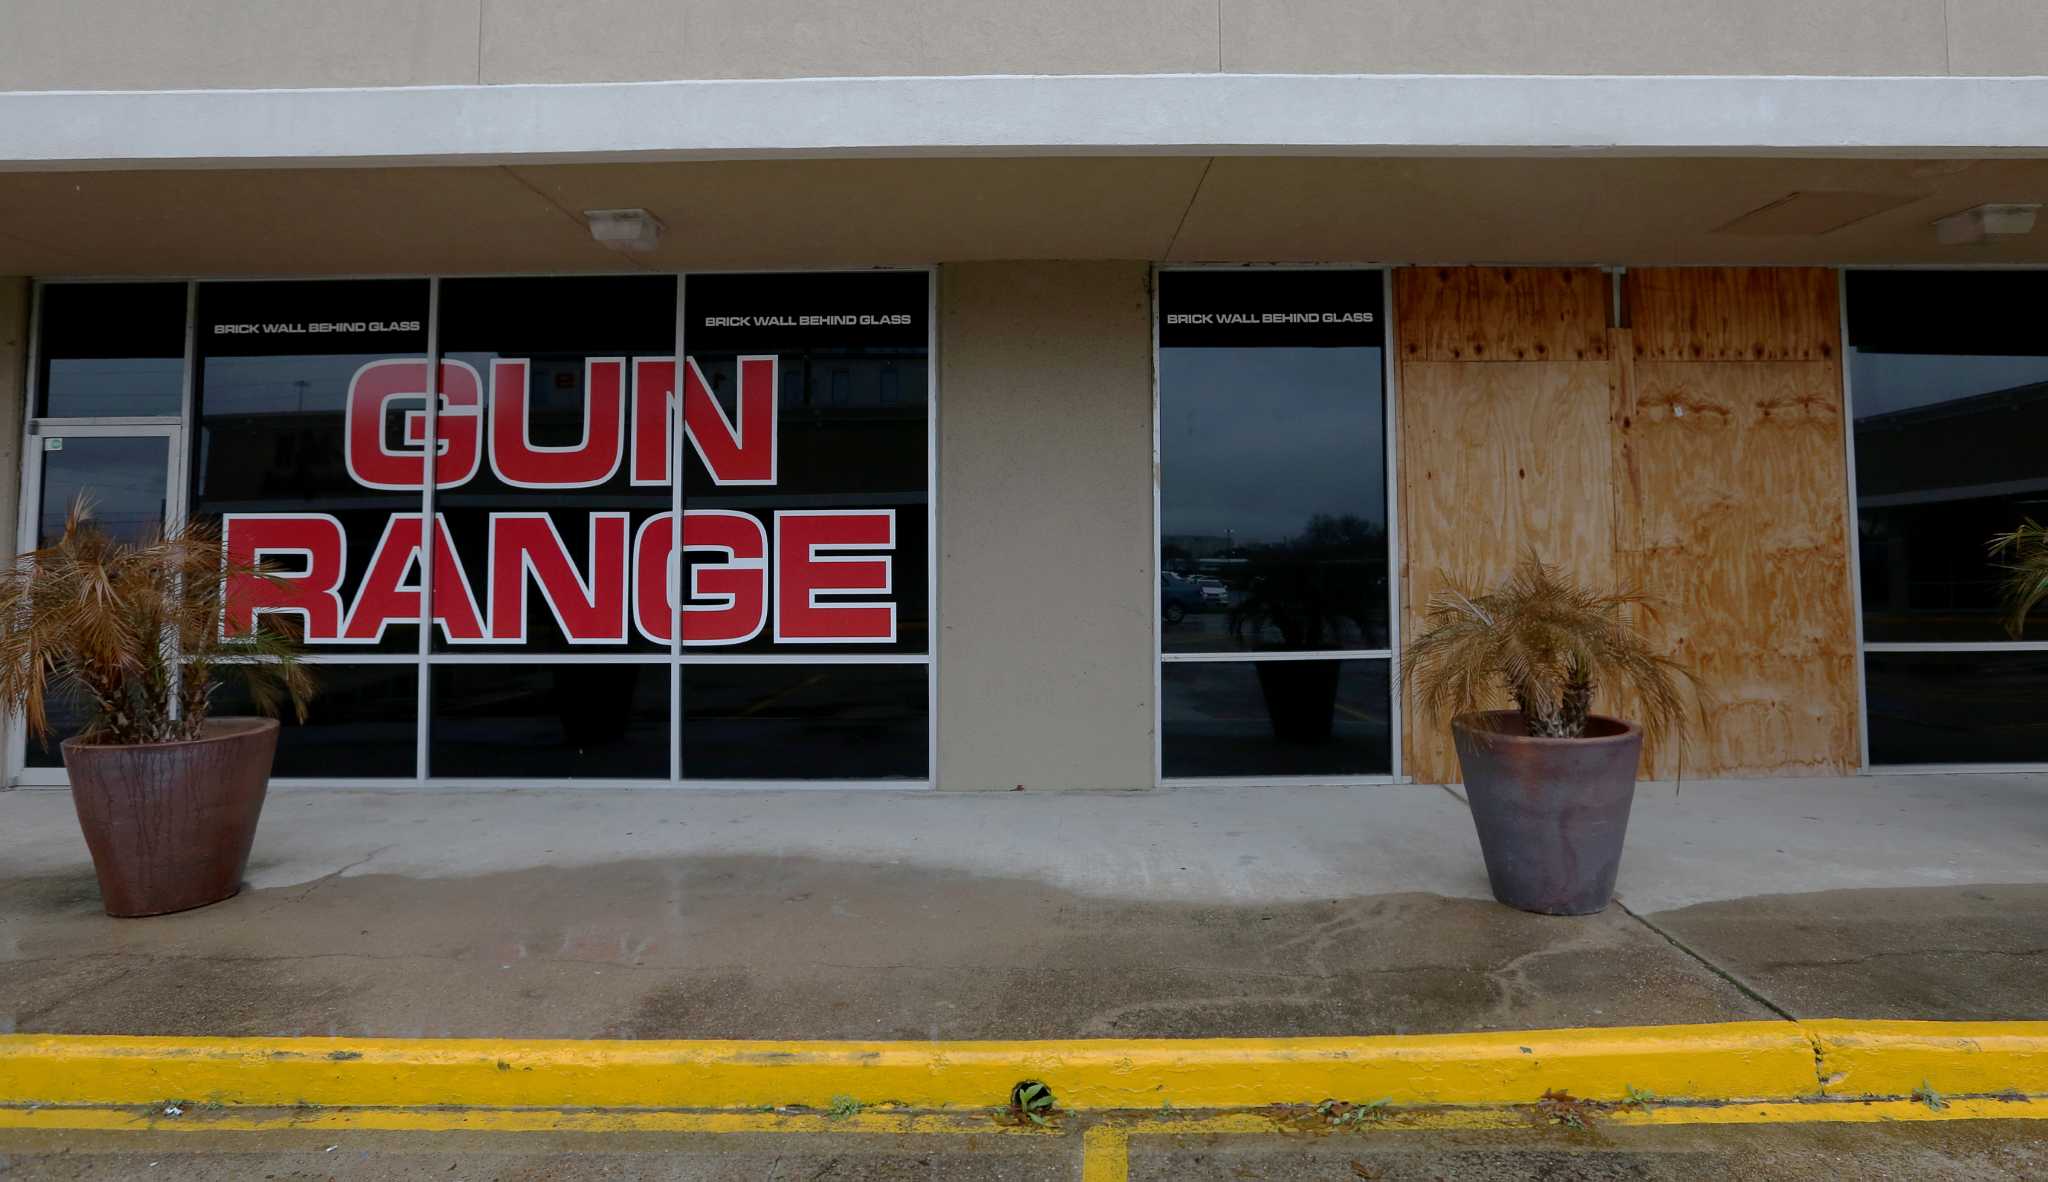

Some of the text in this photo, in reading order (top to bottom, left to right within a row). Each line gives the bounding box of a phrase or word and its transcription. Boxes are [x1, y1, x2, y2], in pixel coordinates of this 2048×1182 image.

[705, 315, 912, 327] BRICK WALL BEHIND GLASS
[1167, 313, 1374, 324] BRICK WALL BEHIND GLASS
[214, 321, 421, 334] BRICK WALL BEHIND GLASS
[344, 354, 779, 489] GUN
[218, 508, 897, 646] RANGE
